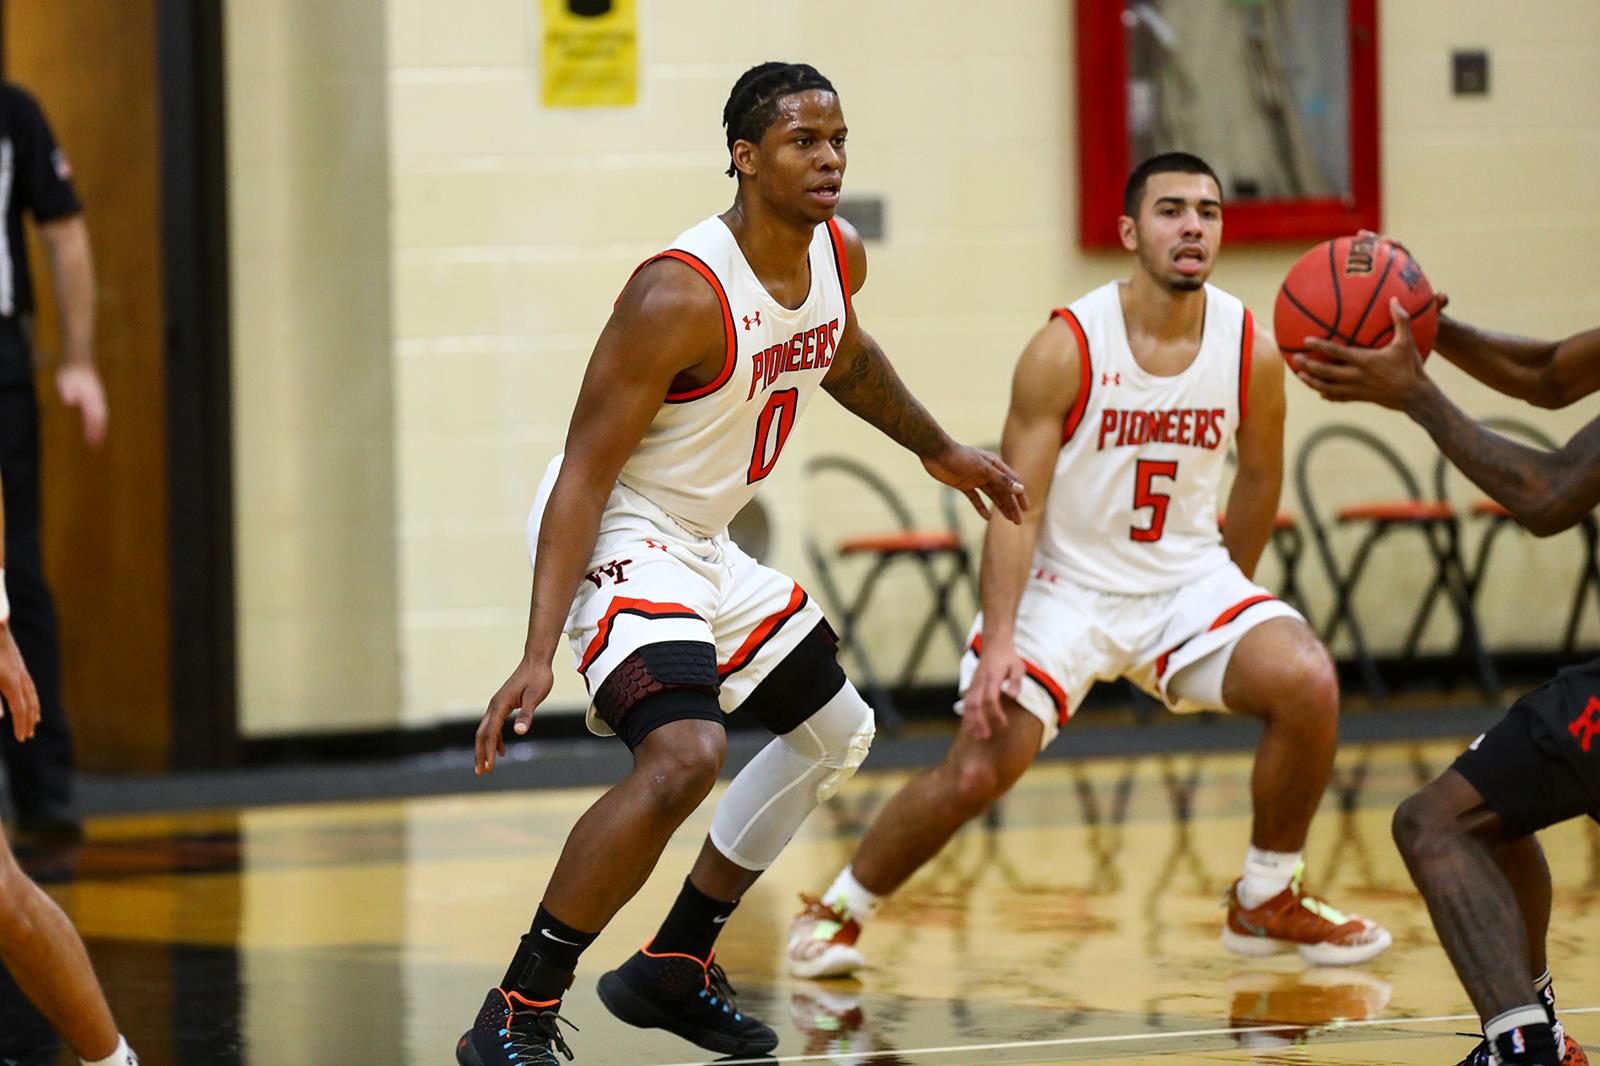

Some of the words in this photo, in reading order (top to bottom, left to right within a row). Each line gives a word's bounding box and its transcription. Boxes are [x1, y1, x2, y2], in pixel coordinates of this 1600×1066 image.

[747, 387, 798, 485] 0
[1097, 409, 1225, 450] PIONEERS
[1130, 459, 1178, 541] 5
